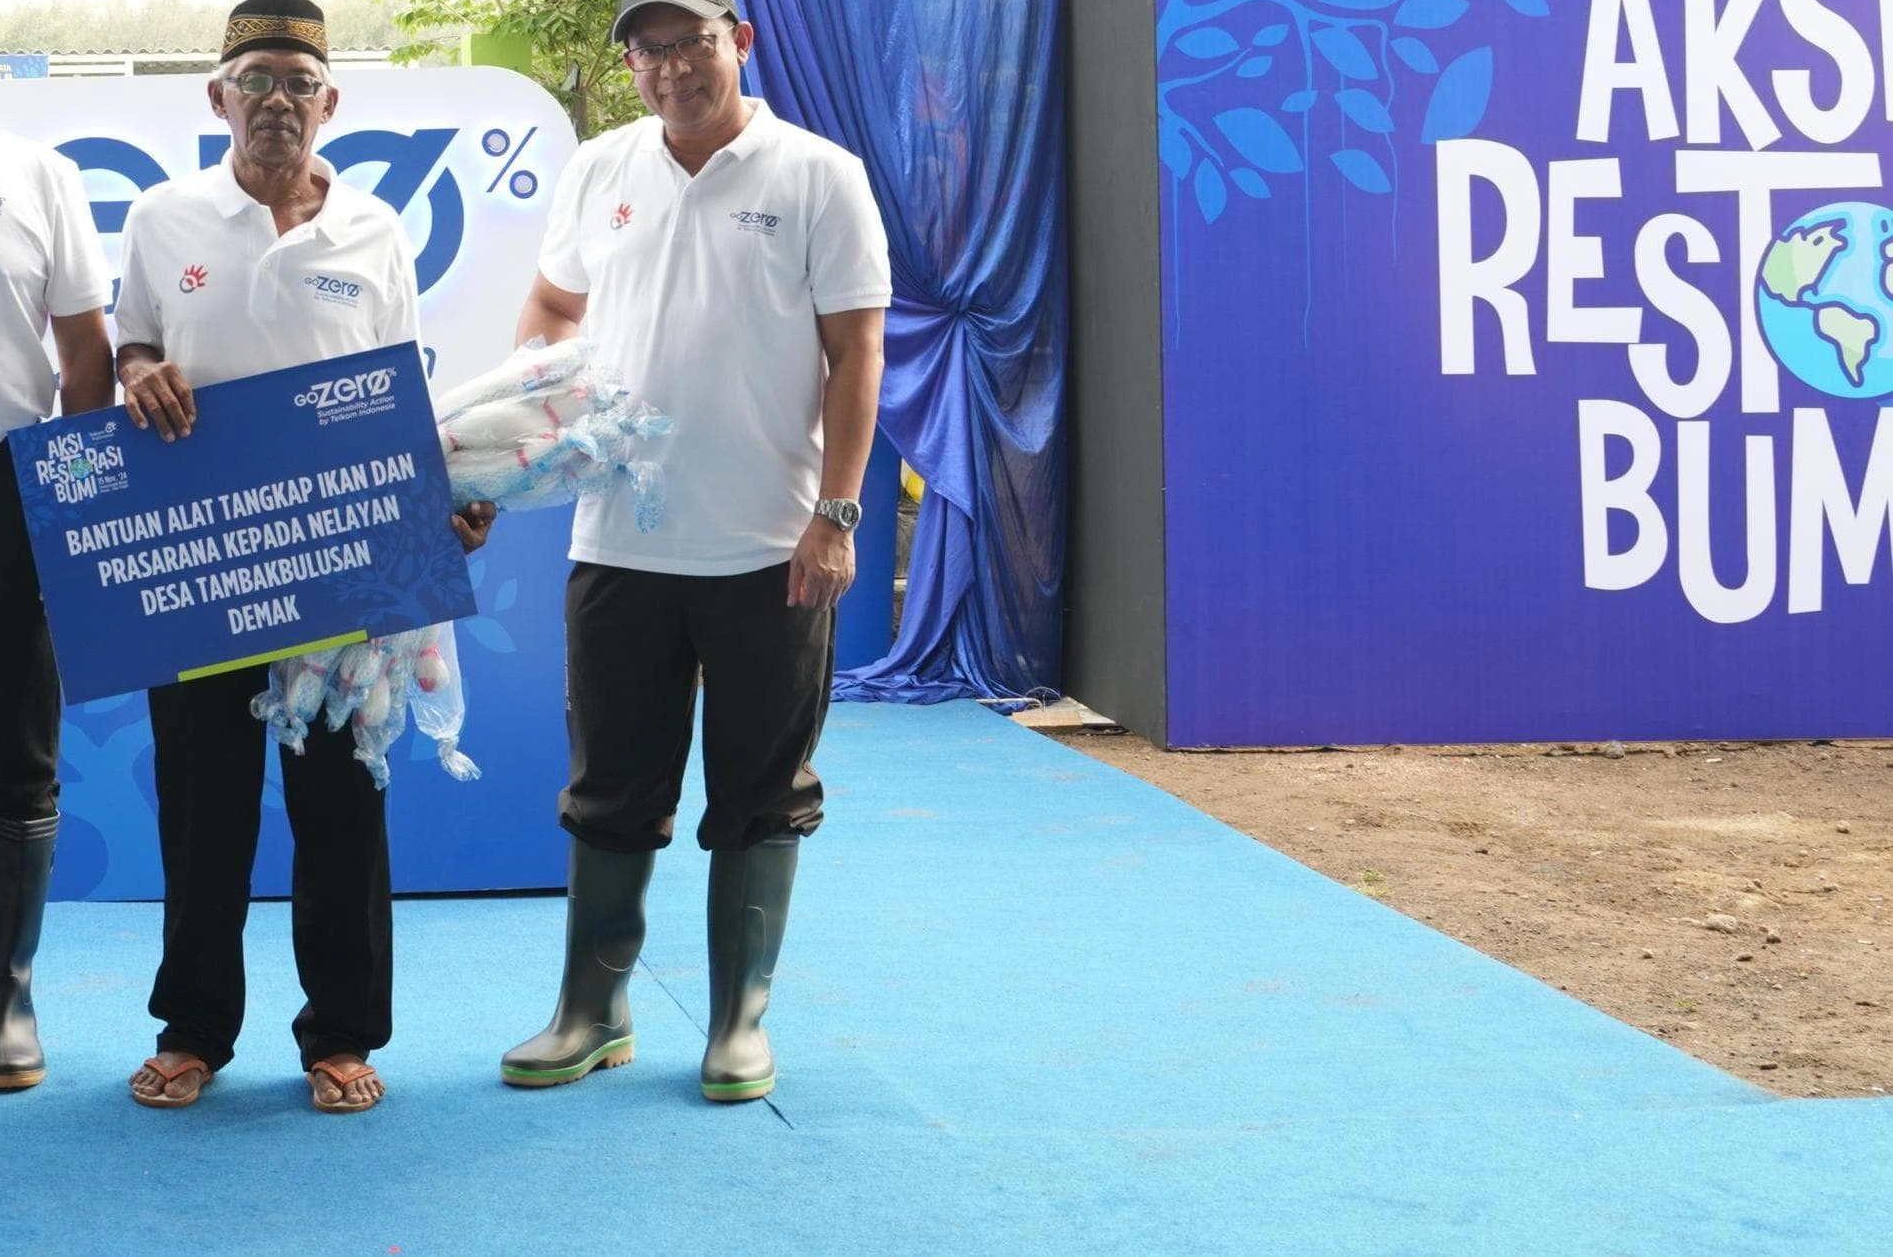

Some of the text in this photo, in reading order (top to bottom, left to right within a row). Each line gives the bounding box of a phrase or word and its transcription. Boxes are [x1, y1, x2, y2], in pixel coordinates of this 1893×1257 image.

[317, 395, 395, 419] Sustainability Action
[331, 412, 358, 423] Telkom
[359, 403, 396, 417] Indonesia
[47, 432, 84, 459] AKSI
[55, 474, 97, 504] BUMI
[66, 453, 416, 556] BANTUAN ALAT TANGKAP IKAN DAN
[98, 495, 401, 587] PRASARANA KEPADA NELAYAN
[141, 540, 371, 616] DESA TAMBAKBULUSAN
[227, 596, 301, 635] DEMAK
